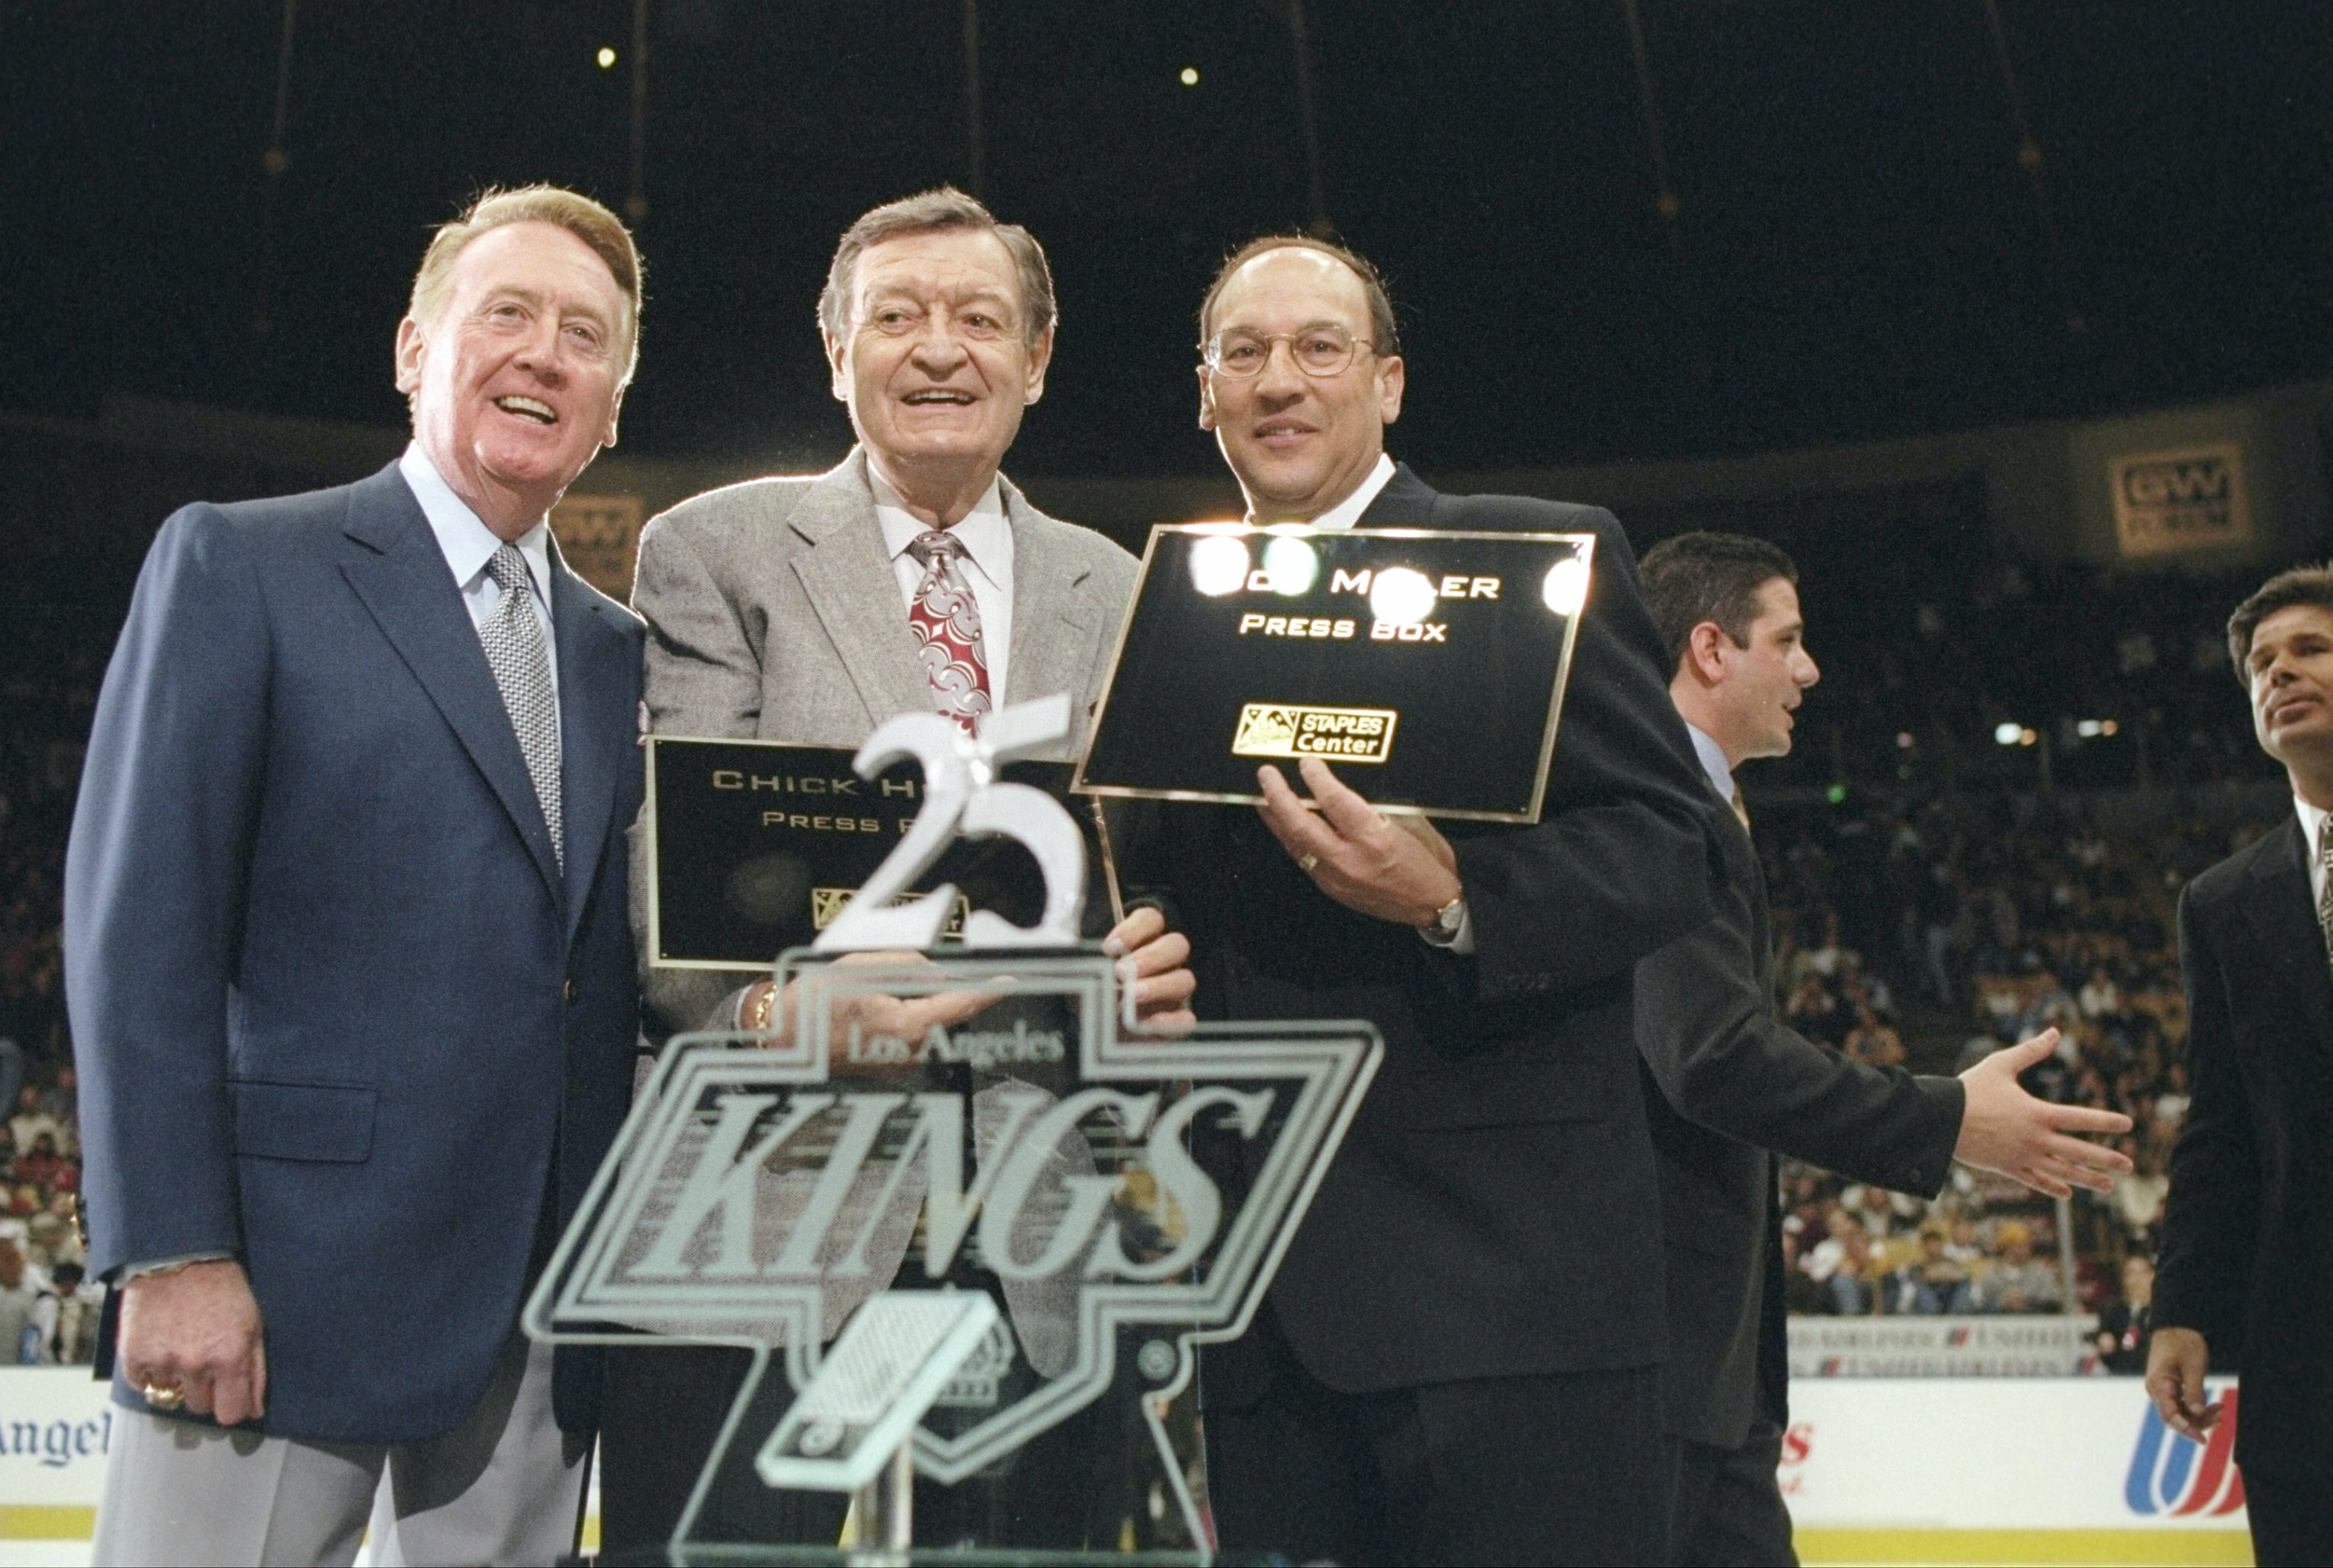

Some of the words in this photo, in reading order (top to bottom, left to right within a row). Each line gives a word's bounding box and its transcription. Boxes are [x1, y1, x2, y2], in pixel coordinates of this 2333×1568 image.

[1297, 733, 1378, 754] Center
[1302, 714, 1384, 735] STAPLES
[811, 692, 1086, 949] 25
[847, 1021, 911, 1064] Los
[914, 1019, 1065, 1073] Angeles
[625, 1086, 1277, 1282] KINGS
